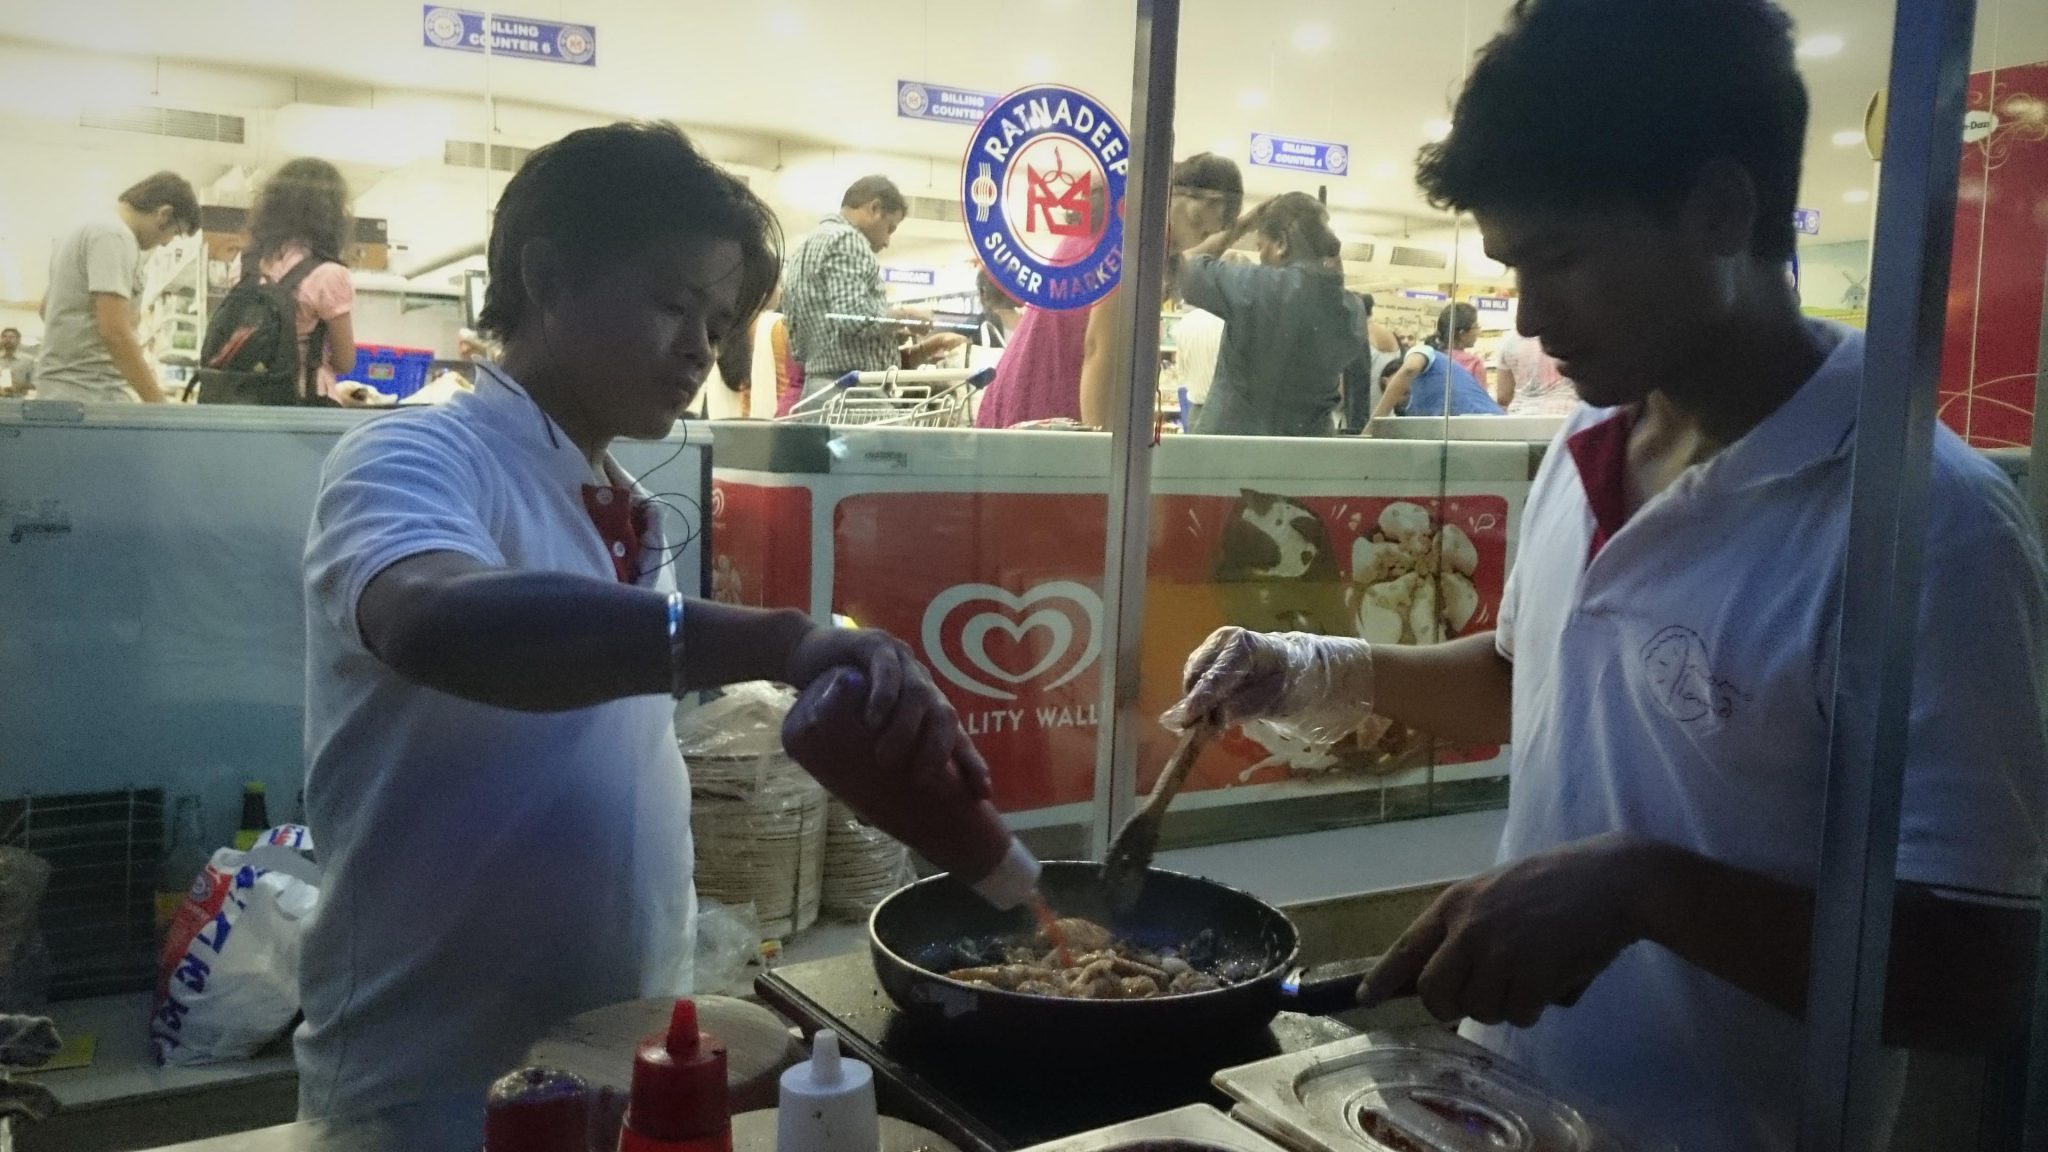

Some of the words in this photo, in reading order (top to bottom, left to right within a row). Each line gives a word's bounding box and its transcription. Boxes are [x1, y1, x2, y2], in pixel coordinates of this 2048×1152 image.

[941, 92, 984, 107] BILLING
[985, 97, 1129, 176] RATNADEEP
[1275, 153, 1315, 167] COUNTER
[1282, 142, 1316, 156] BILLING
[984, 232, 1042, 294] SUPER
[960, 709, 1024, 735] LITY
[1036, 704, 1098, 728] WALL
